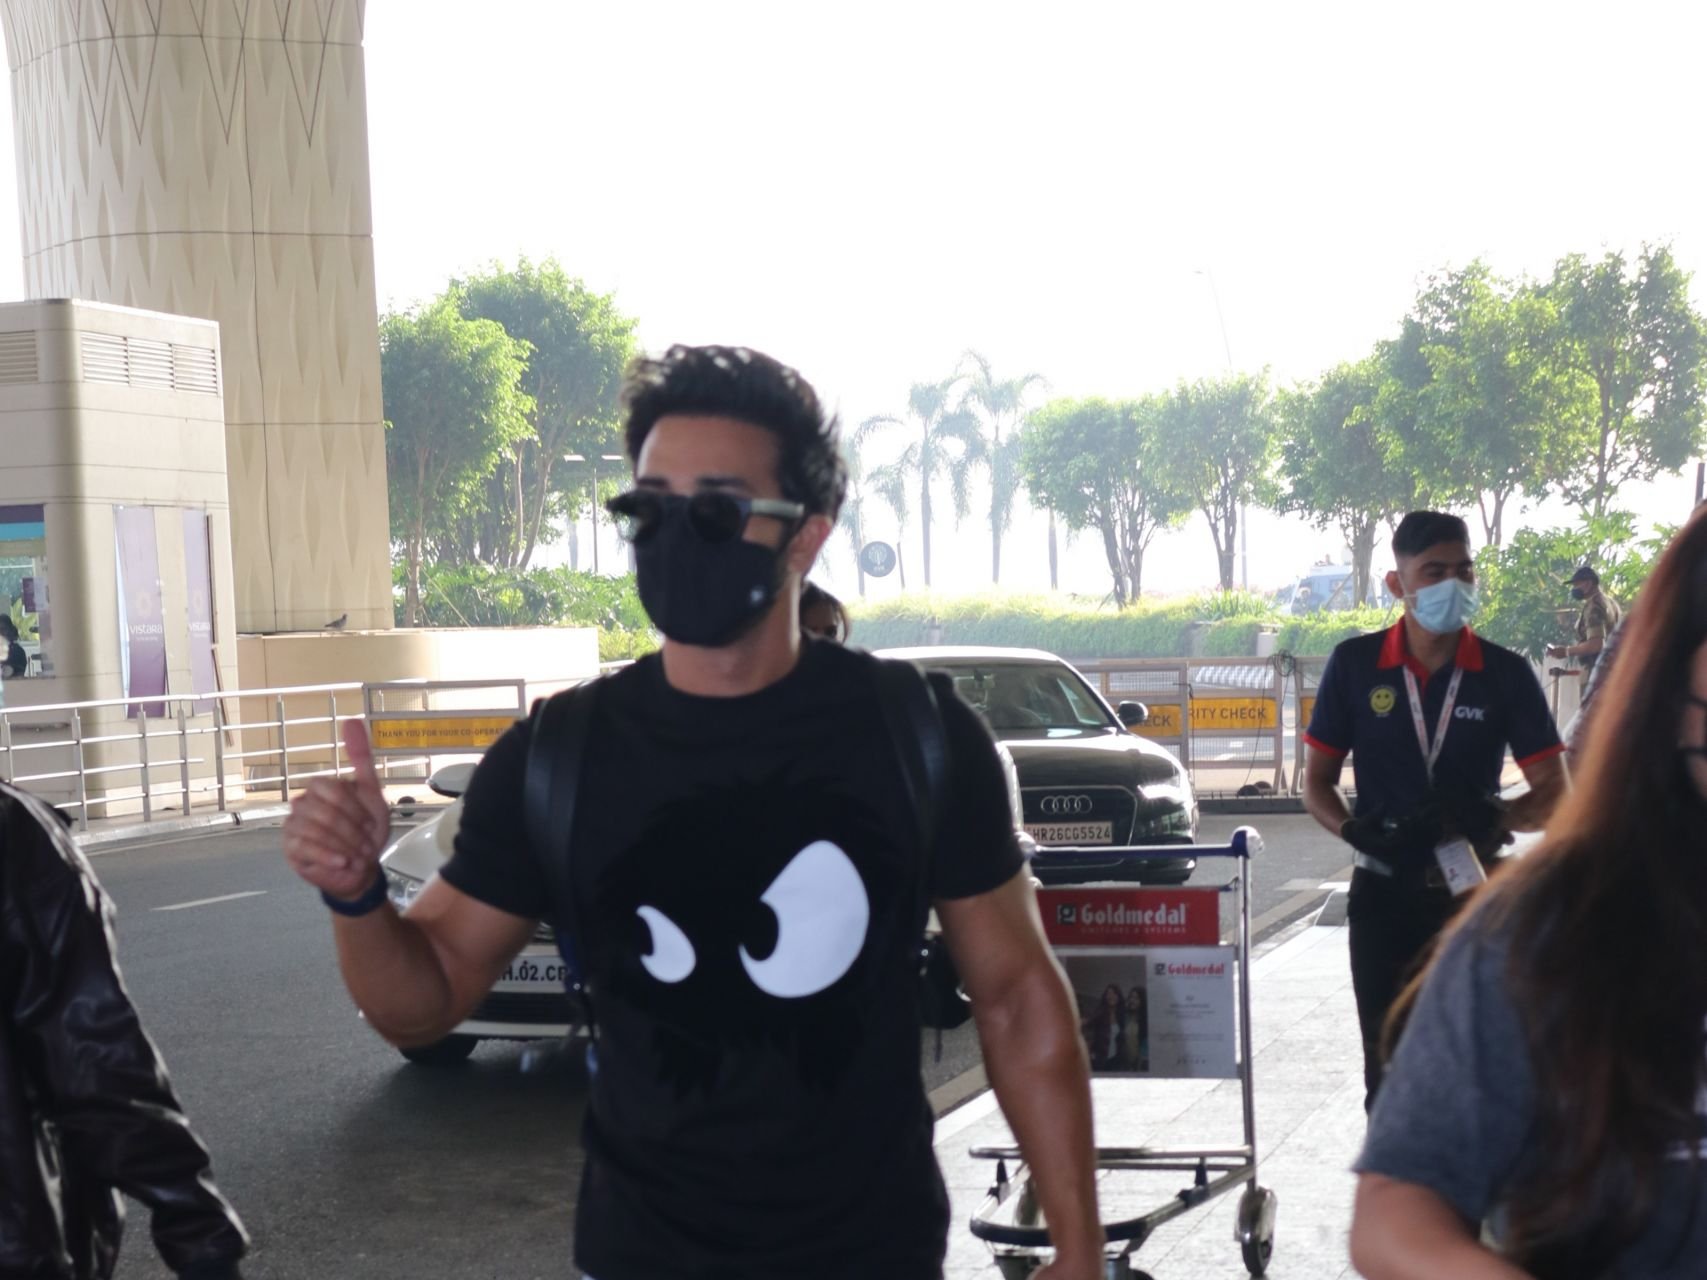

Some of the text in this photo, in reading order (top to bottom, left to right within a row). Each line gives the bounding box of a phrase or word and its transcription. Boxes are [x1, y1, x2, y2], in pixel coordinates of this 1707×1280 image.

[1220, 707, 1268, 720] CHECK
[1454, 705, 1485, 721] GVK
[1142, 714, 1172, 727] ECK
[405, 729, 421, 737] YOU
[461, 726, 505, 737] CO-OPERAT
[1081, 902, 1187, 926] Goldmedal
